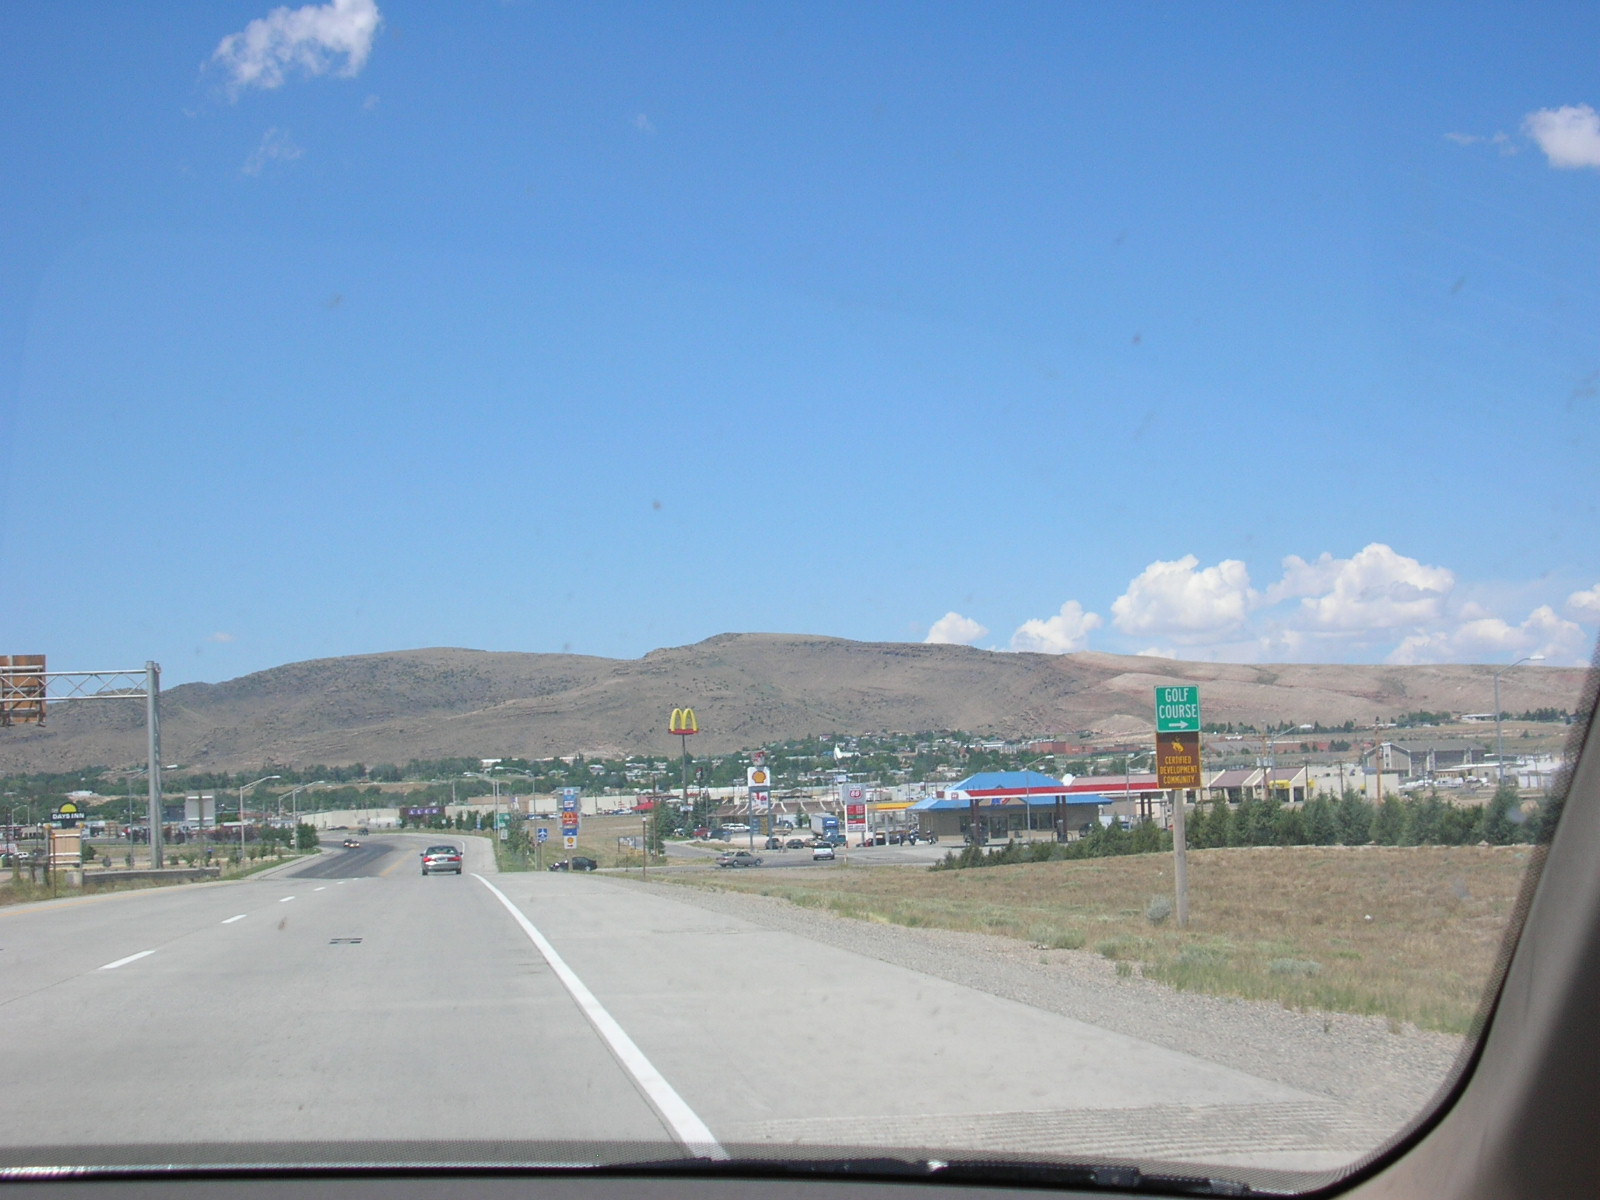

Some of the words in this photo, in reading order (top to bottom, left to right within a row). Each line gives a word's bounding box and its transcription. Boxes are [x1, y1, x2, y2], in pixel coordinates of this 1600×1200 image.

[1165, 688, 1189, 702] GOLF
[1159, 704, 1197, 718] COURSE
[1165, 756, 1192, 764] CERTIFIED
[1160, 765, 1199, 774] DEVELOPMENT
[1163, 775, 1195, 784] COMMUNITY
